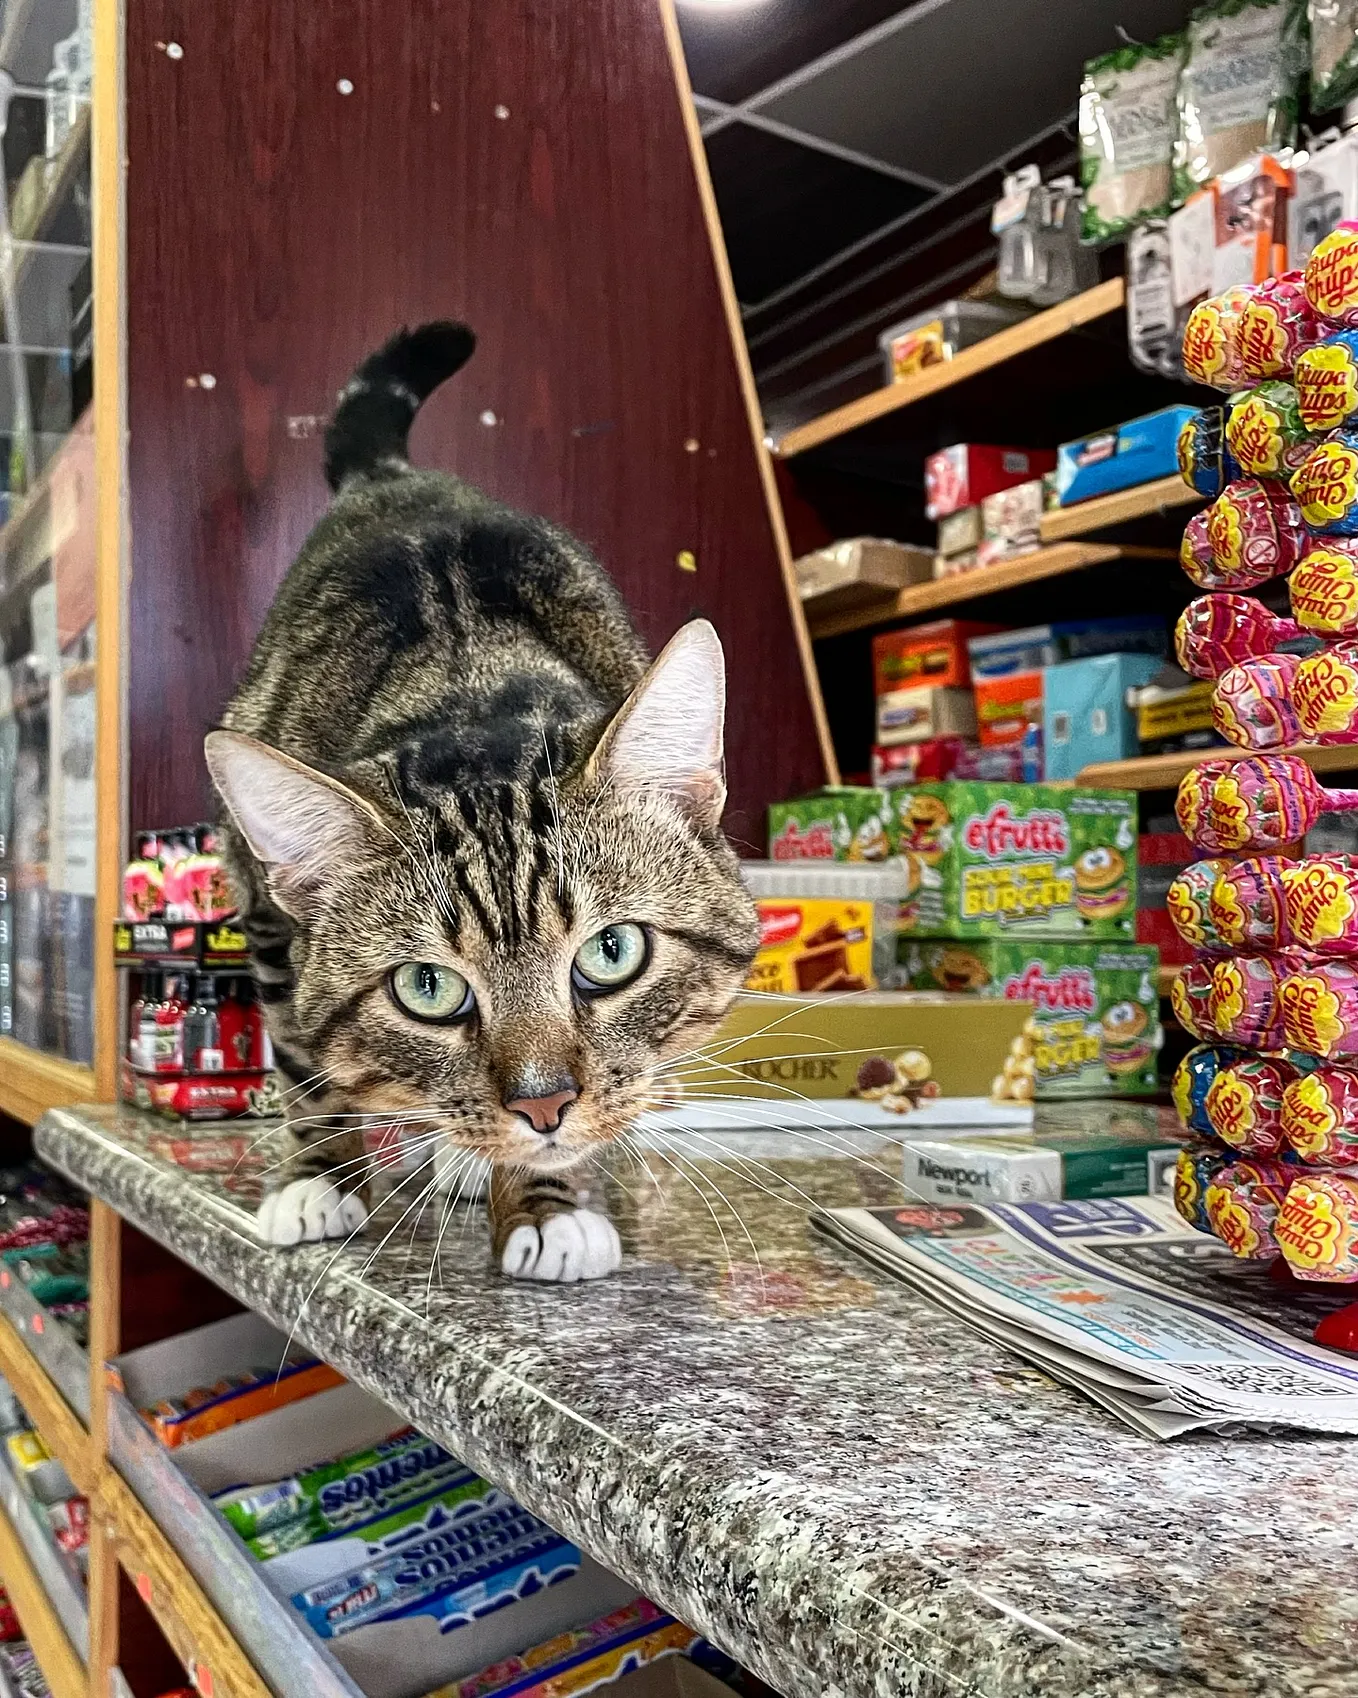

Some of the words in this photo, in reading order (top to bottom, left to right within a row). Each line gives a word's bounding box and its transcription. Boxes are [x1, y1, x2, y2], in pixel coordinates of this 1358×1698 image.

[966, 803, 1067, 858] efrutti
[964, 879, 1073, 915] BURGER
[1035, 1037, 1100, 1069] RGER
[917, 1157, 991, 1188] Newport
